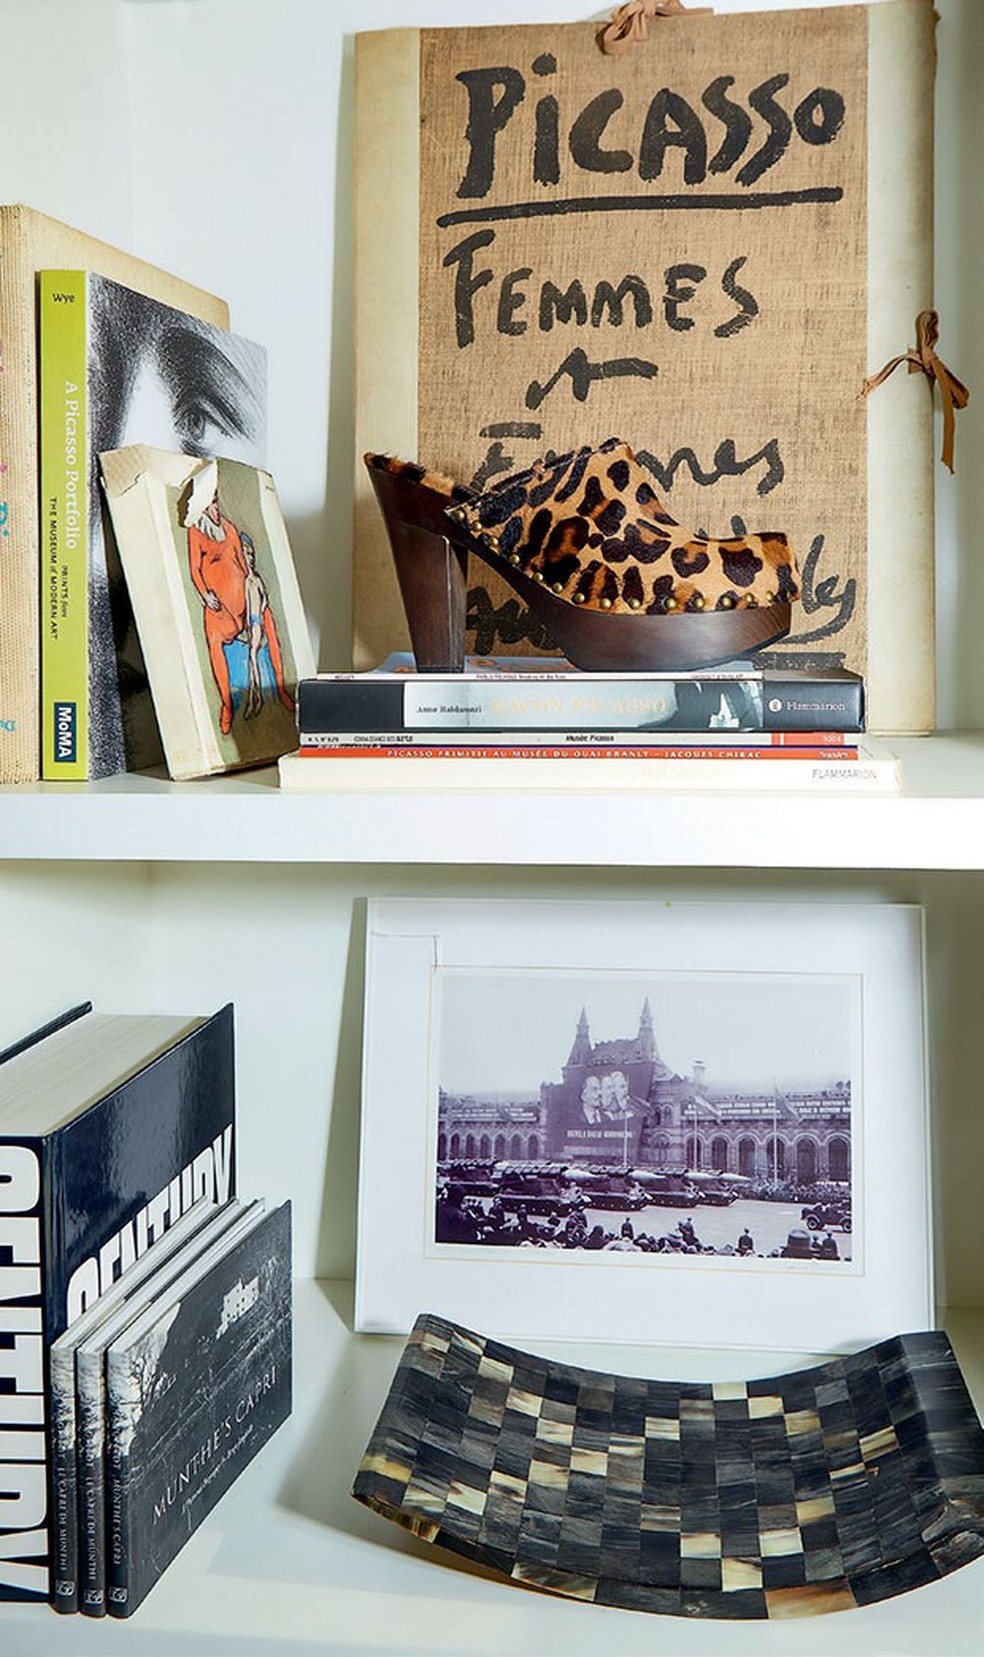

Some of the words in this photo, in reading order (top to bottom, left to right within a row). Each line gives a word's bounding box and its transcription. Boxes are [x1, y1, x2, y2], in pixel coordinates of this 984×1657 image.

[52, 292, 75, 304] Wye
[64, 380, 79, 395] A
[64, 399, 80, 467] Picasso
[50, 497, 58, 516] THE
[65, 469, 80, 550] Portfolio
[50, 519, 58, 564] MUSEUM
[50, 576, 58, 619] MODERN
[61, 564, 69, 599] PRINTS
[50, 620, 59, 640] ART
[492, 698, 563, 713] BACON
[786, 700, 846, 711] Flammarion
[58, 707, 72, 758] MoMA
[386, 749, 433, 758] PICASSO
[492, 749, 508, 758] AU
[606, 750, 650, 758] BRANLY
[664, 750, 713, 758] JACQUES
[718, 750, 762, 759] CHIRAC
[152, 1415, 232, 1524] MUNTHE'S
[235, 1365, 276, 1423] CAPRI
[87, 1537, 96, 1581] MUNTHE
